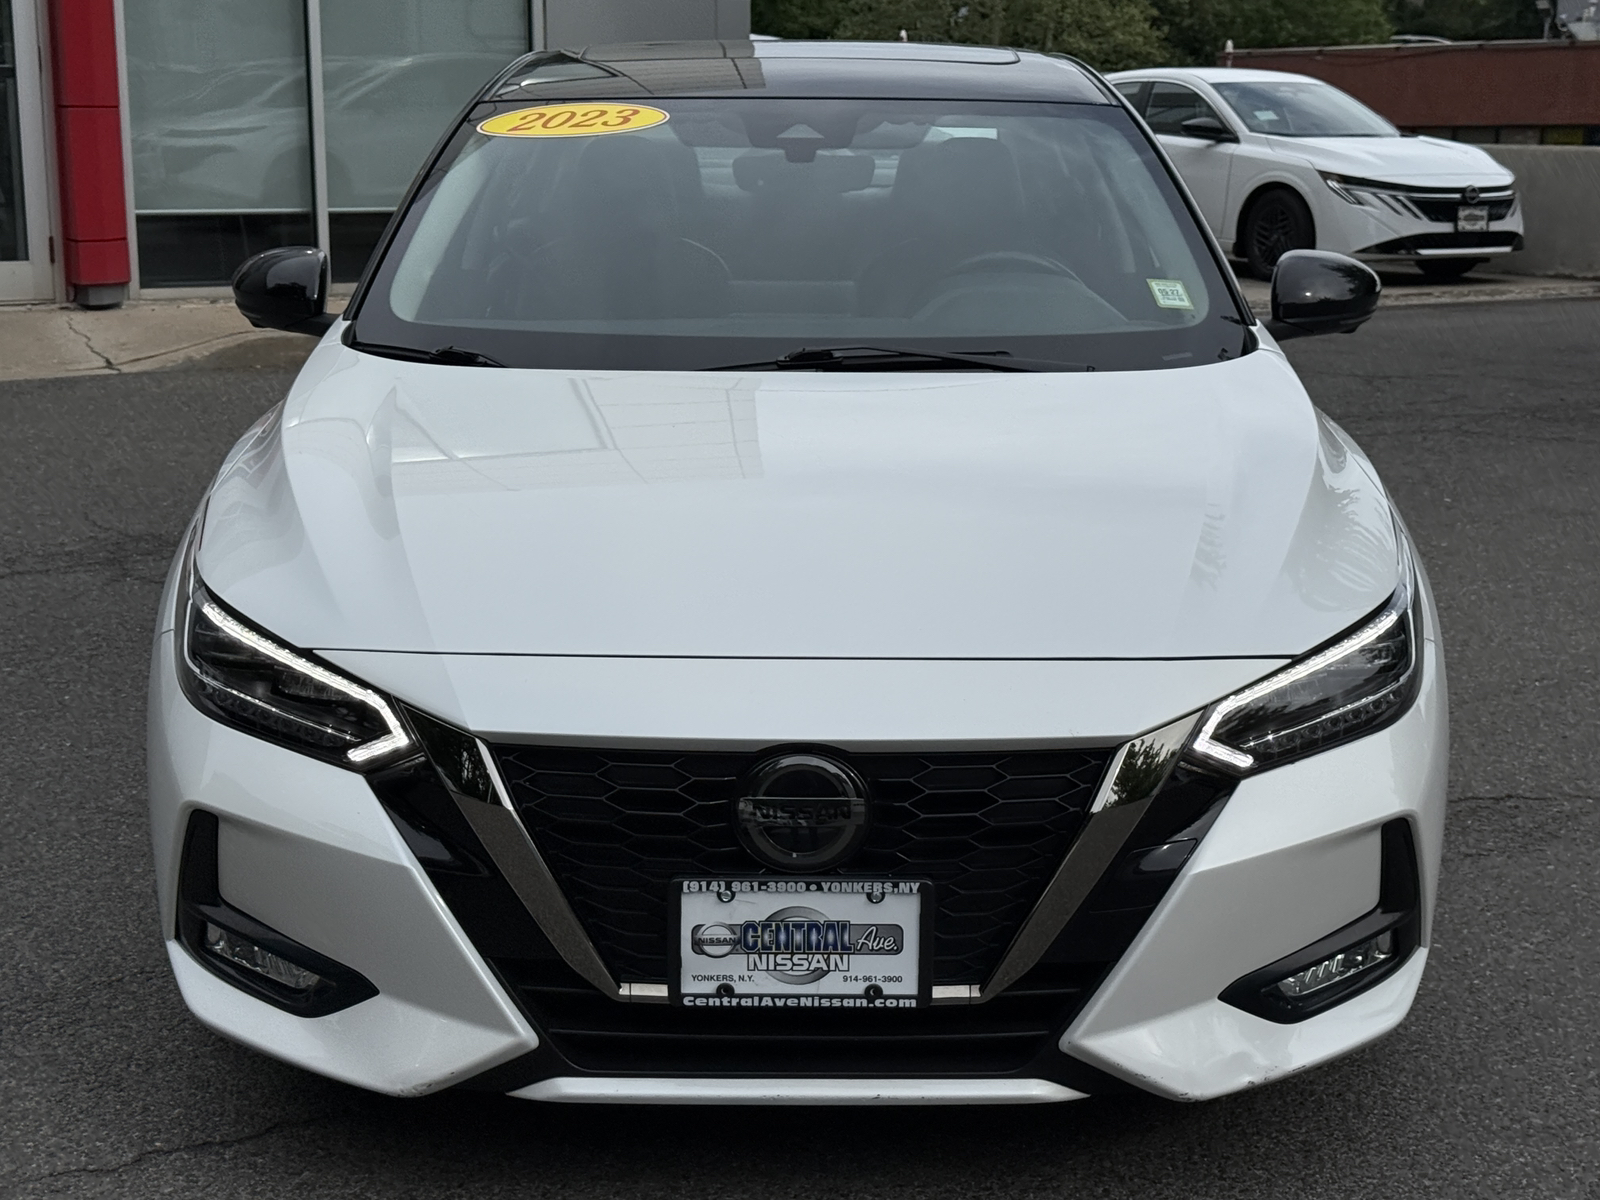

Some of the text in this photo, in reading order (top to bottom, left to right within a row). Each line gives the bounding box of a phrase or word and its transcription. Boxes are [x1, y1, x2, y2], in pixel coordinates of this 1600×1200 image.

[506, 108, 641, 132] 2023
[755, 804, 851, 821] NISSAN
[682, 881, 726, 893] (914)
[731, 881, 806, 893] 961-3900
[741, 921, 899, 954] CENTRAL Ave.
[747, 953, 850, 972] NISSAN
[691, 974, 755, 983] YONKERS, N.Y.
[842, 975, 903, 983] 914-961-3900
[682, 996, 917, 1007] CentralAveNissan.com
